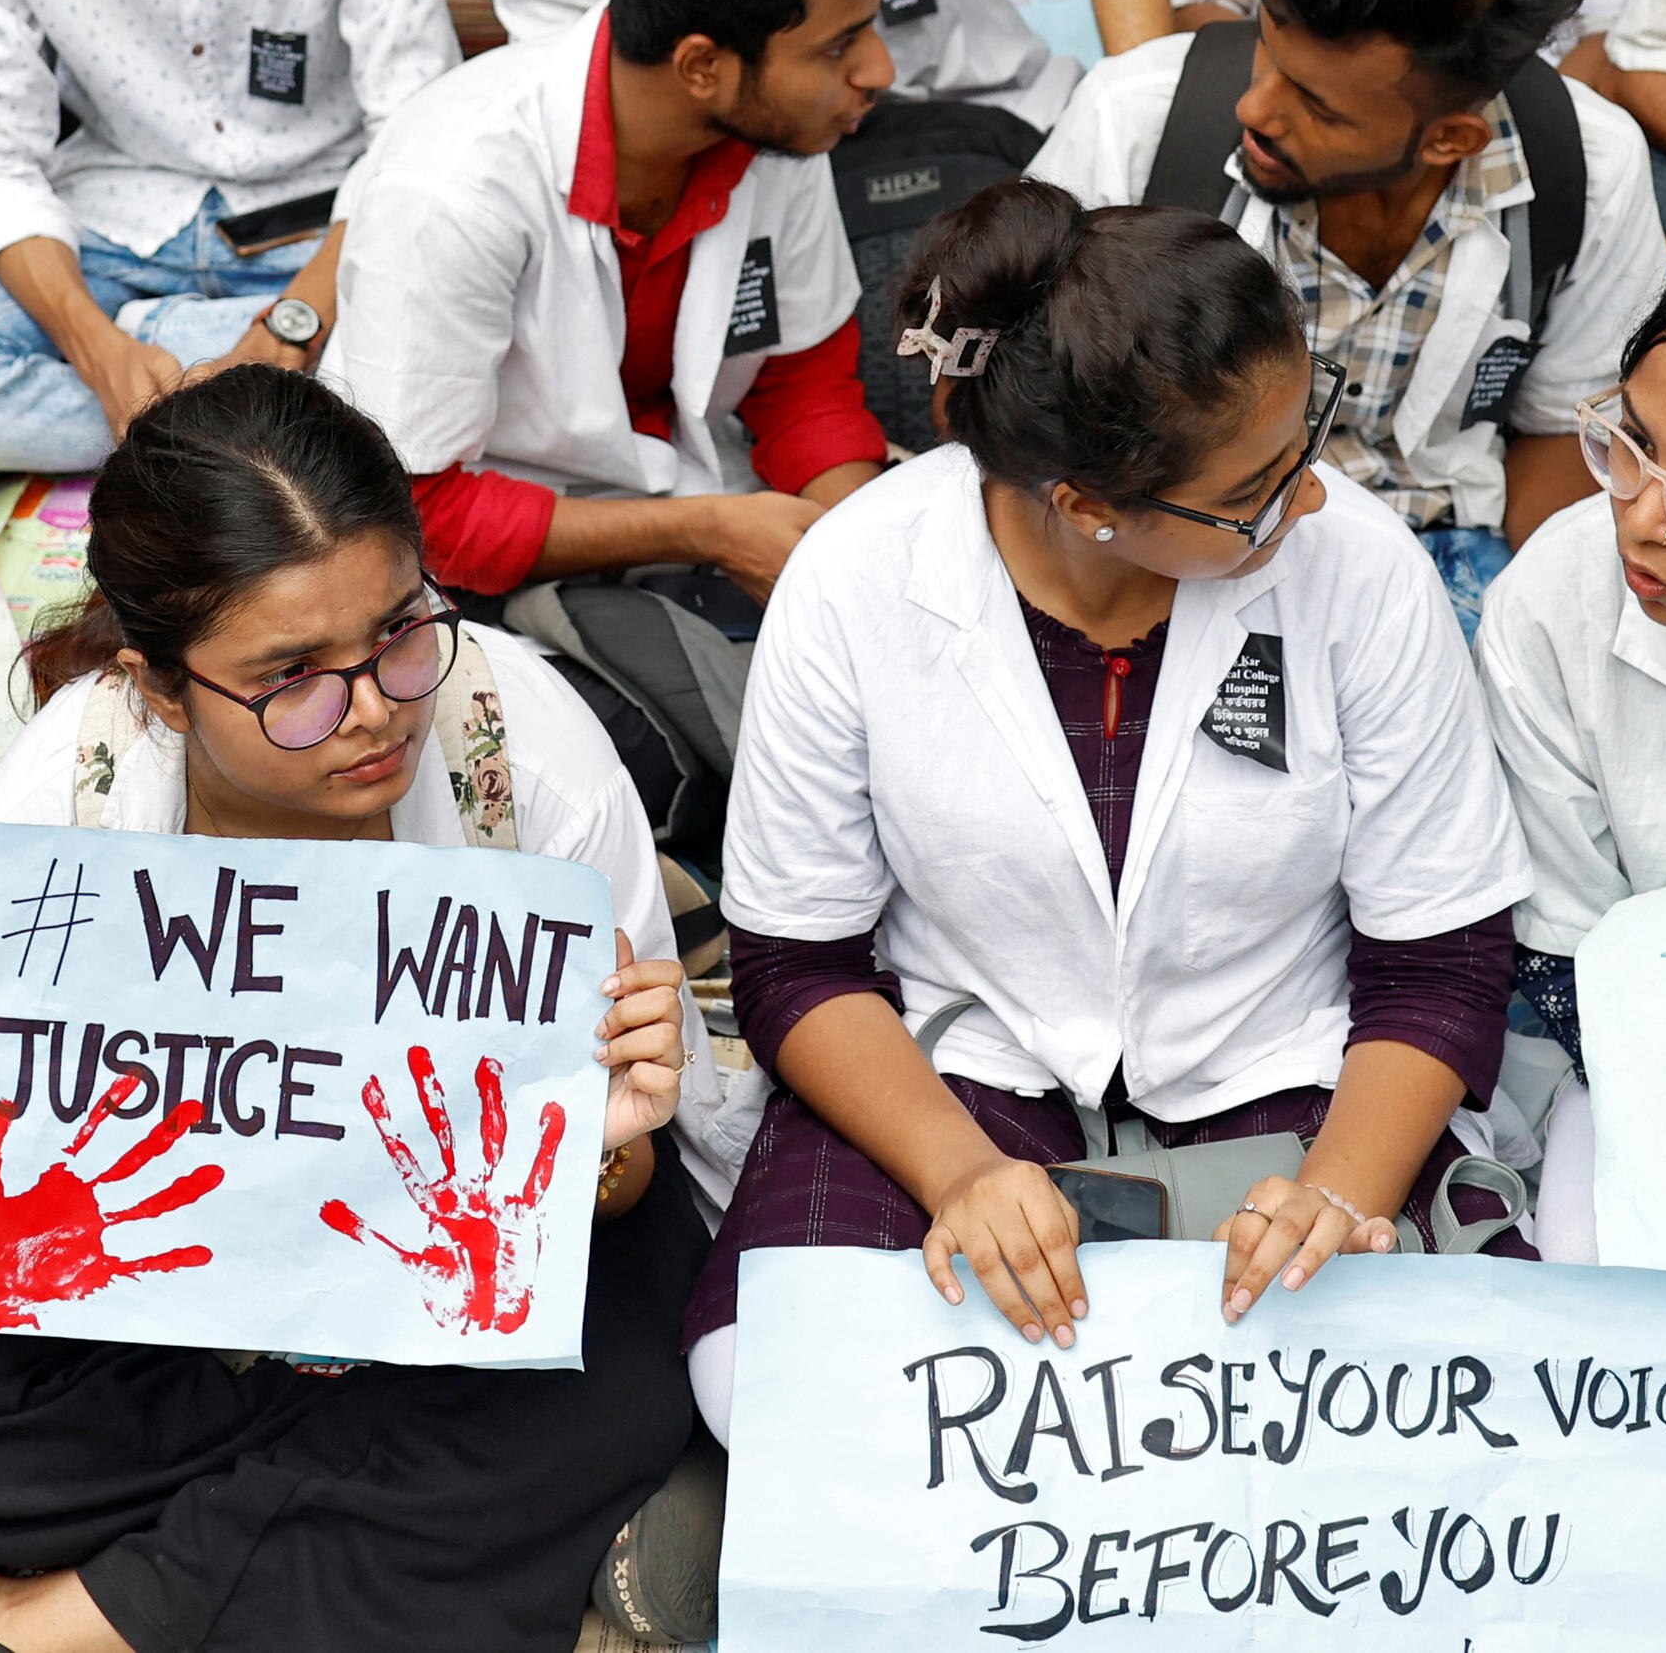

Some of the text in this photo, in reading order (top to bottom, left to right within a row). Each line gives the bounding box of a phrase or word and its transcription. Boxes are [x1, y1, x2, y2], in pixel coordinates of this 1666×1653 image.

[871, 168, 935, 194] HRX
[1241, 655, 1261, 667] Kar
[1243, 669, 1281, 683] College
[1225, 683, 1269, 696] Hospital
[0, 857, 594, 1025] # WE WANT
[904, 1346, 1256, 1504] RAISE
[1260, 1347, 1520, 1466] YOUR
[968, 1506, 1563, 1643] BEFORE YOU
